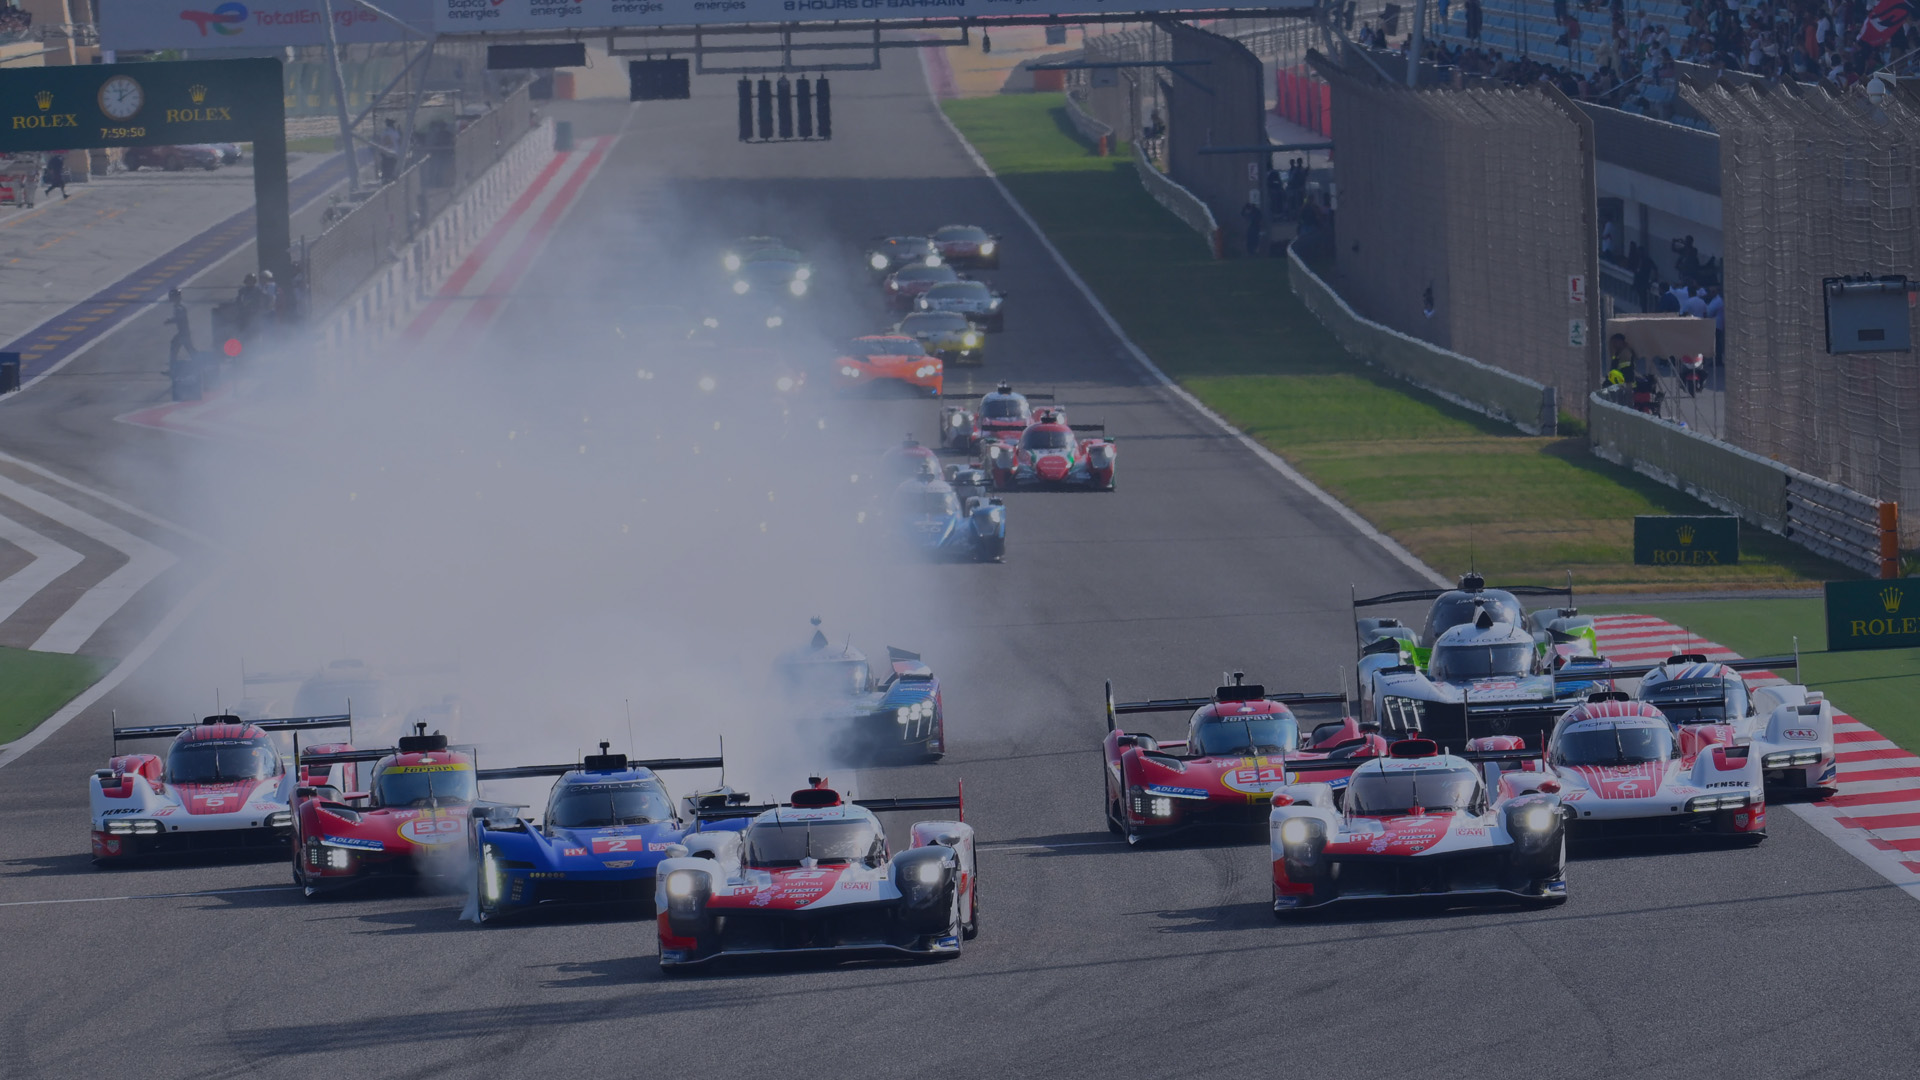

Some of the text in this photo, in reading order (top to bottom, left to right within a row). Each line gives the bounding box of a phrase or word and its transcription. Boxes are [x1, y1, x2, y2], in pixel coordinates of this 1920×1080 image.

[530, 5, 583, 17] energies
[612, 2, 664, 14] energies
[694, 0, 746, 12] energies
[784, 1, 795, 11] 8
[798, 0, 858, 10] HOURS
[861, 0, 885, 8] OF
[253, 9, 378, 27] TotalEnrgies
[448, 9, 501, 20] energies
[166, 106, 232, 124] ROLEX
[12, 114, 78, 130] ROLEX
[100, 127, 146, 139] 7:59:50
[1653, 549, 1718, 565] ROLEX
[1851, 617, 1920, 636] ROLE
[1660, 682, 1731, 692] PORSCHE
[1221, 714, 1274, 723] Ferrari
[1579, 720, 1653, 728] PORSCHE
[184, 741, 252, 749] PORSCHE
[1238, 769, 1282, 782] 51
[570, 782, 650, 792] CADILLAC
[1617, 781, 1638, 790] 6
[1705, 781, 1750, 789] PENSKE
[206, 796, 224, 807] 5
[101, 808, 146, 817] PENSKE
[415, 820, 458, 833] 50
[328, 836, 361, 845] ADLER
[1351, 834, 1372, 842] HY
[607, 840, 628, 852] 2
[565, 848, 585, 856] HY
[735, 886, 756, 896] HY
